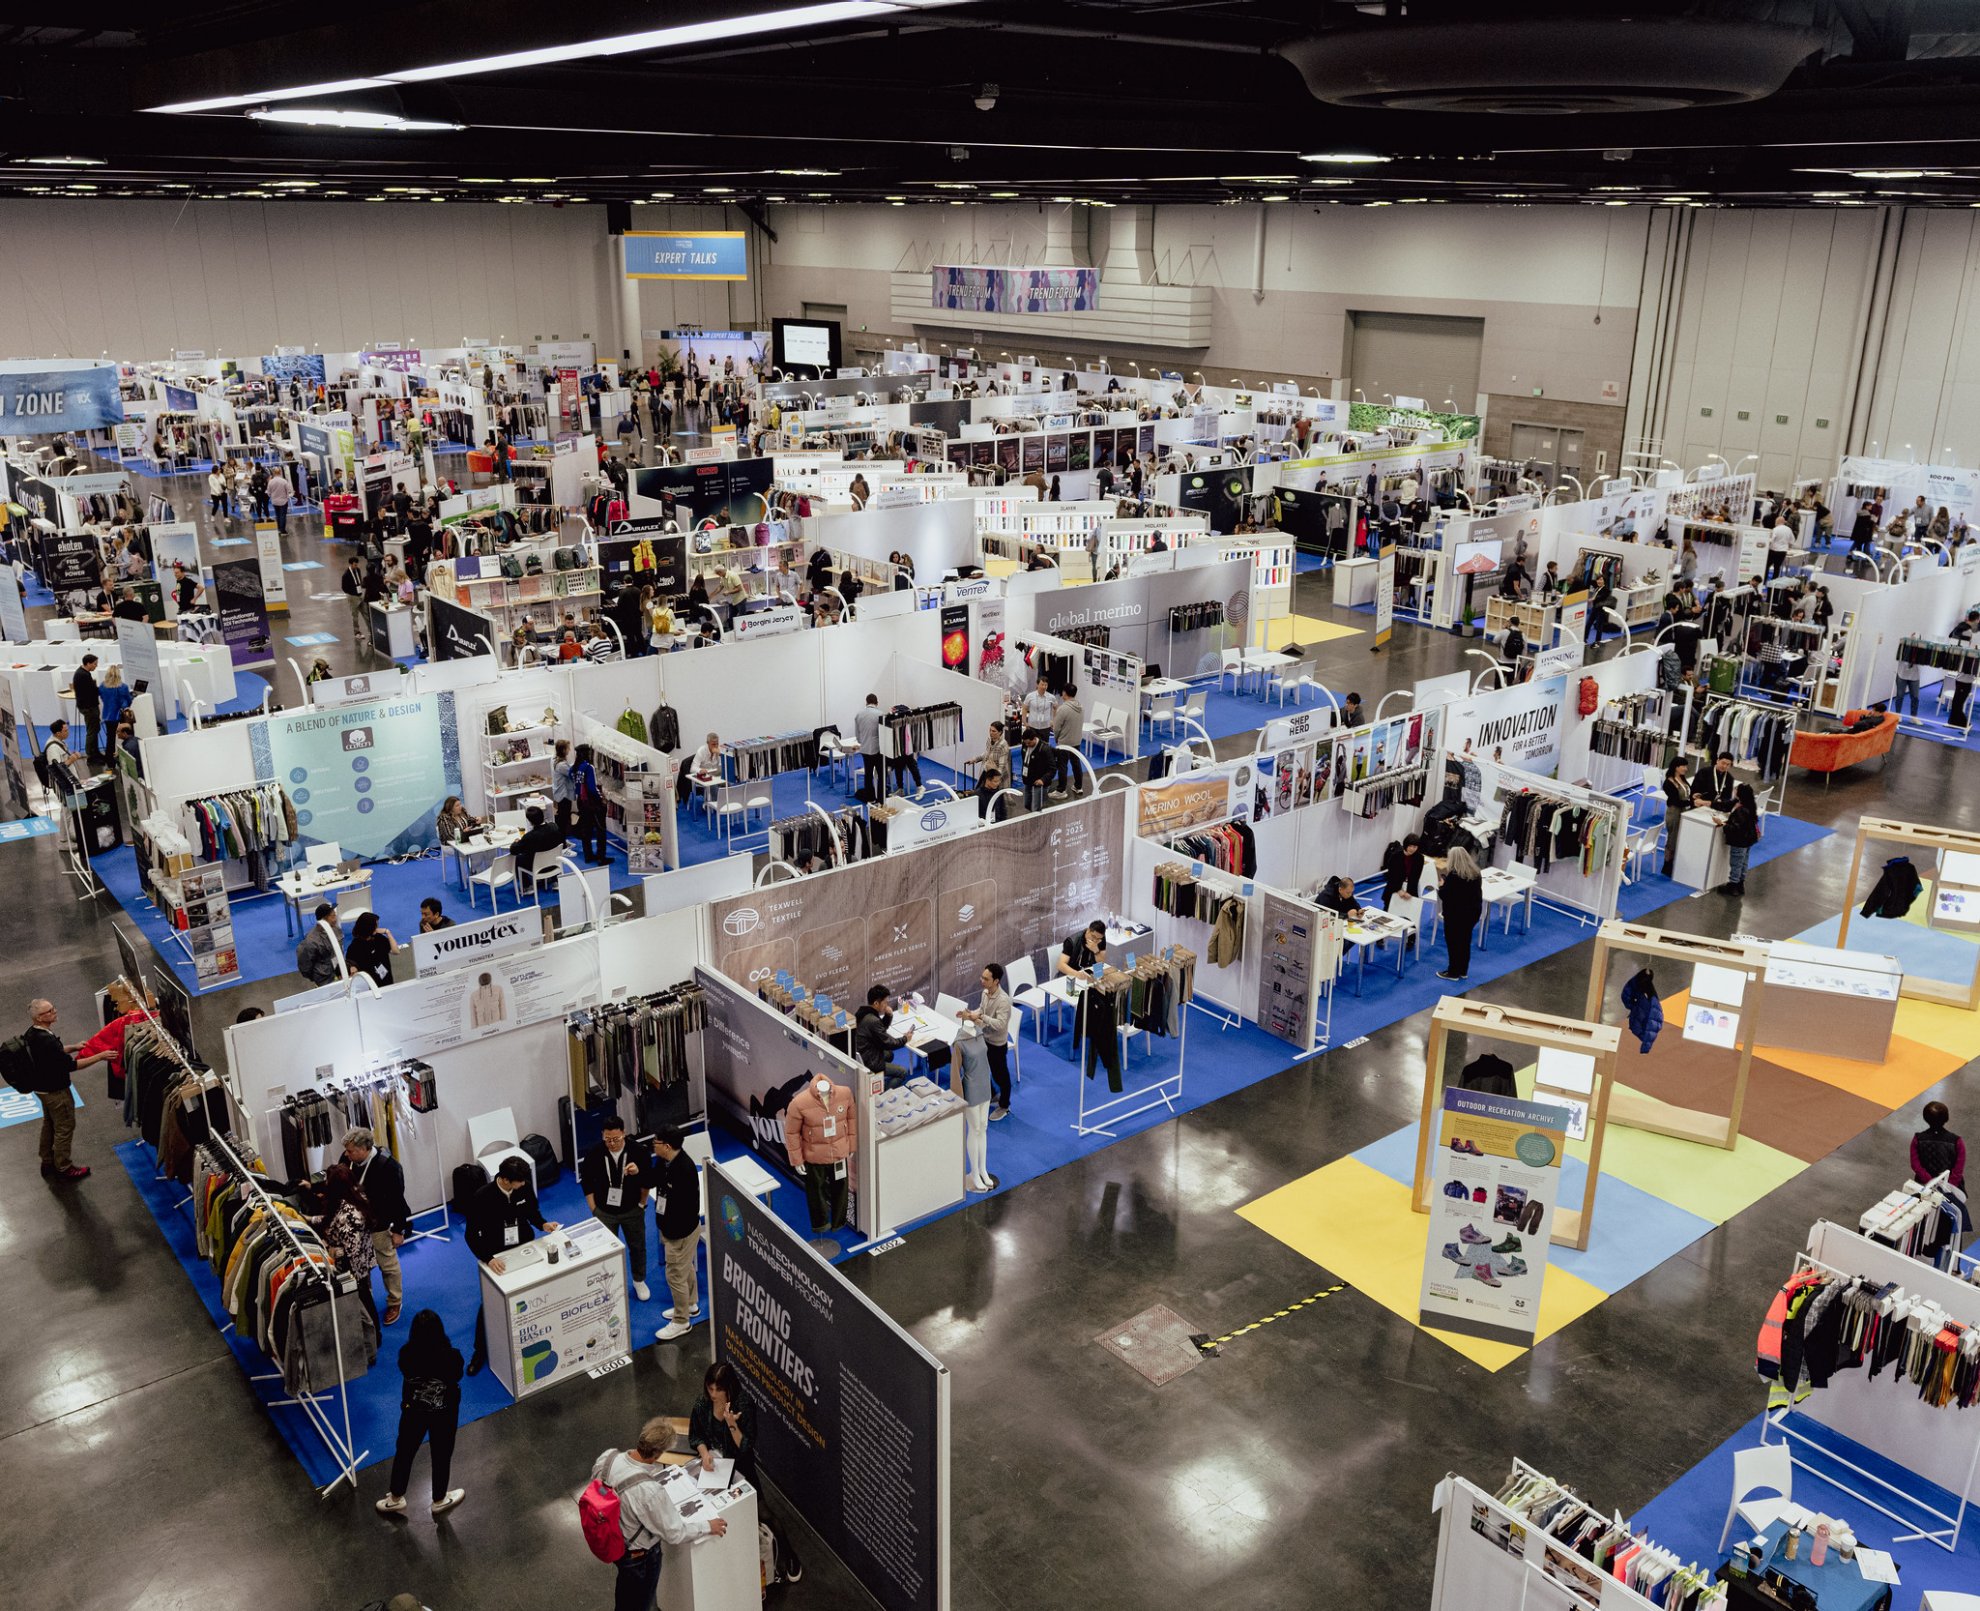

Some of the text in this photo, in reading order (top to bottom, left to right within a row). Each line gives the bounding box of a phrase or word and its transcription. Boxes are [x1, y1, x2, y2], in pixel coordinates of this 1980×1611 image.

[655, 252, 718, 264] EXPERT TALKS
[949, 284, 992, 298] TREND FORUM
[1029, 286, 1082, 299] TREND FORUM
[15, 392, 64, 417] ZONE
[57, 540, 83, 552] ekoten
[747, 615, 794, 629] Borgini Jersey
[1048, 602, 1142, 632] global merino
[286, 702, 422, 734] A BLEND OF NATURE & DESIGN
[1290, 715, 1310, 726] SHEP
[1477, 703, 1558, 748] INNOVATION
[1289, 724, 1310, 737] HERD
[1512, 741, 1523, 751] FOR
[1528, 733, 1548, 748] BETTER
[1144, 790, 1213, 816] MERINO WOOL
[767, 898, 805, 912] TEXWELL
[772, 911, 802, 924] TEXTILE
[433, 922, 519, 960] youngtex
[874, 941, 927, 962] GREEN FLEX SERIES
[420, 966, 437, 974] SOUTH
[420, 971, 438, 979] KOREA
[815, 965, 849, 980] EVO FLEECE
[1457, 1100, 1555, 1124] OUTDOOR RECREATION ARCHIVE
[874, 1239, 900, 1254] 1602
[747, 1222, 833, 1308] NASA TECHNOLOGY
[747, 1235, 834, 1324] TRANSFER PROGRAM
[723, 1252, 792, 1340] BRIDGING
[561, 1294, 611, 1321] BIOFLEX
[518, 1323, 538, 1336] BIO
[519, 1325, 552, 1344] BASED
[735, 1298, 820, 1405] FRONTIERS:
[594, 1358, 626, 1375] 1600
[745, 1344, 794, 1400] TECHNOLOGY
[725, 1339, 826, 1449] OUTDOOR PRODUCT DESIGN
